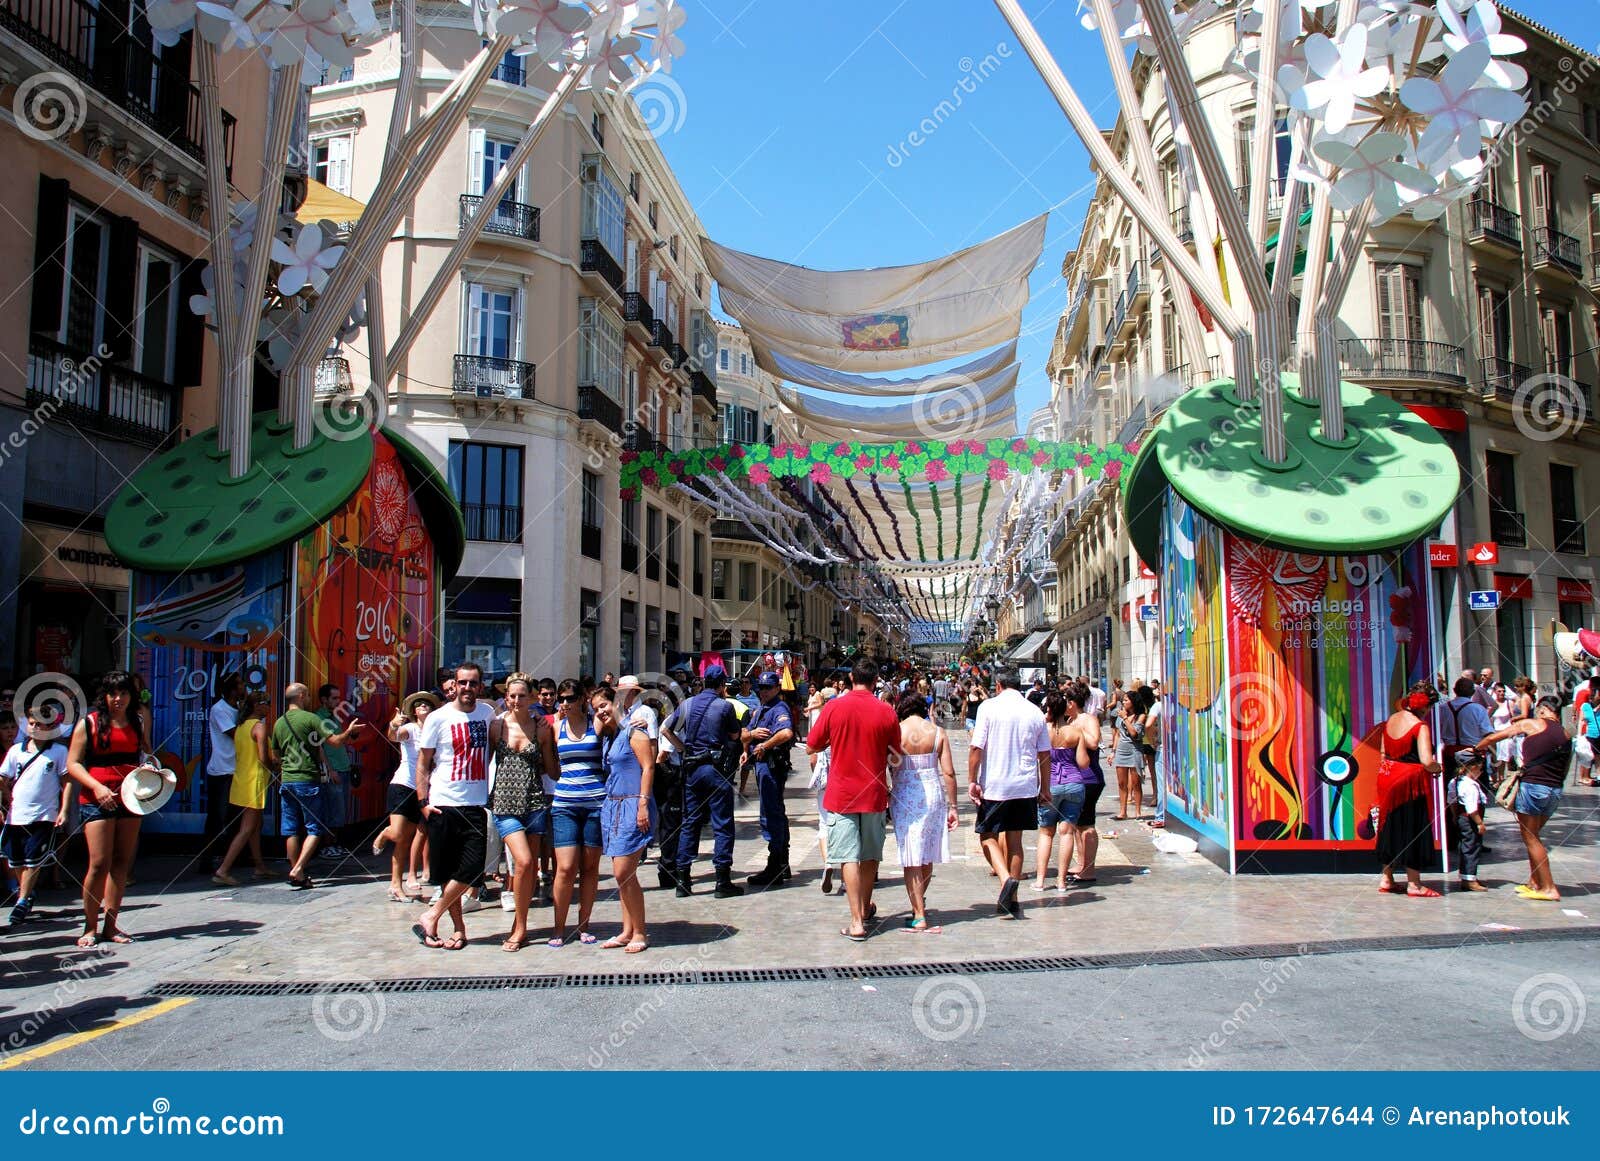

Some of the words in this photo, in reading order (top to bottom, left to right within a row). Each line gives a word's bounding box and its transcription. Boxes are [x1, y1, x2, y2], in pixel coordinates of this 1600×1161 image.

[1273, 618, 1321, 632] ciudad
[1325, 620, 1385, 635] europea
[1284, 634, 1302, 649] de
[1306, 634, 1320, 649] la
[1323, 634, 1377, 649] cultura
[174, 658, 235, 700] 201
[184, 708, 210, 721] mál
